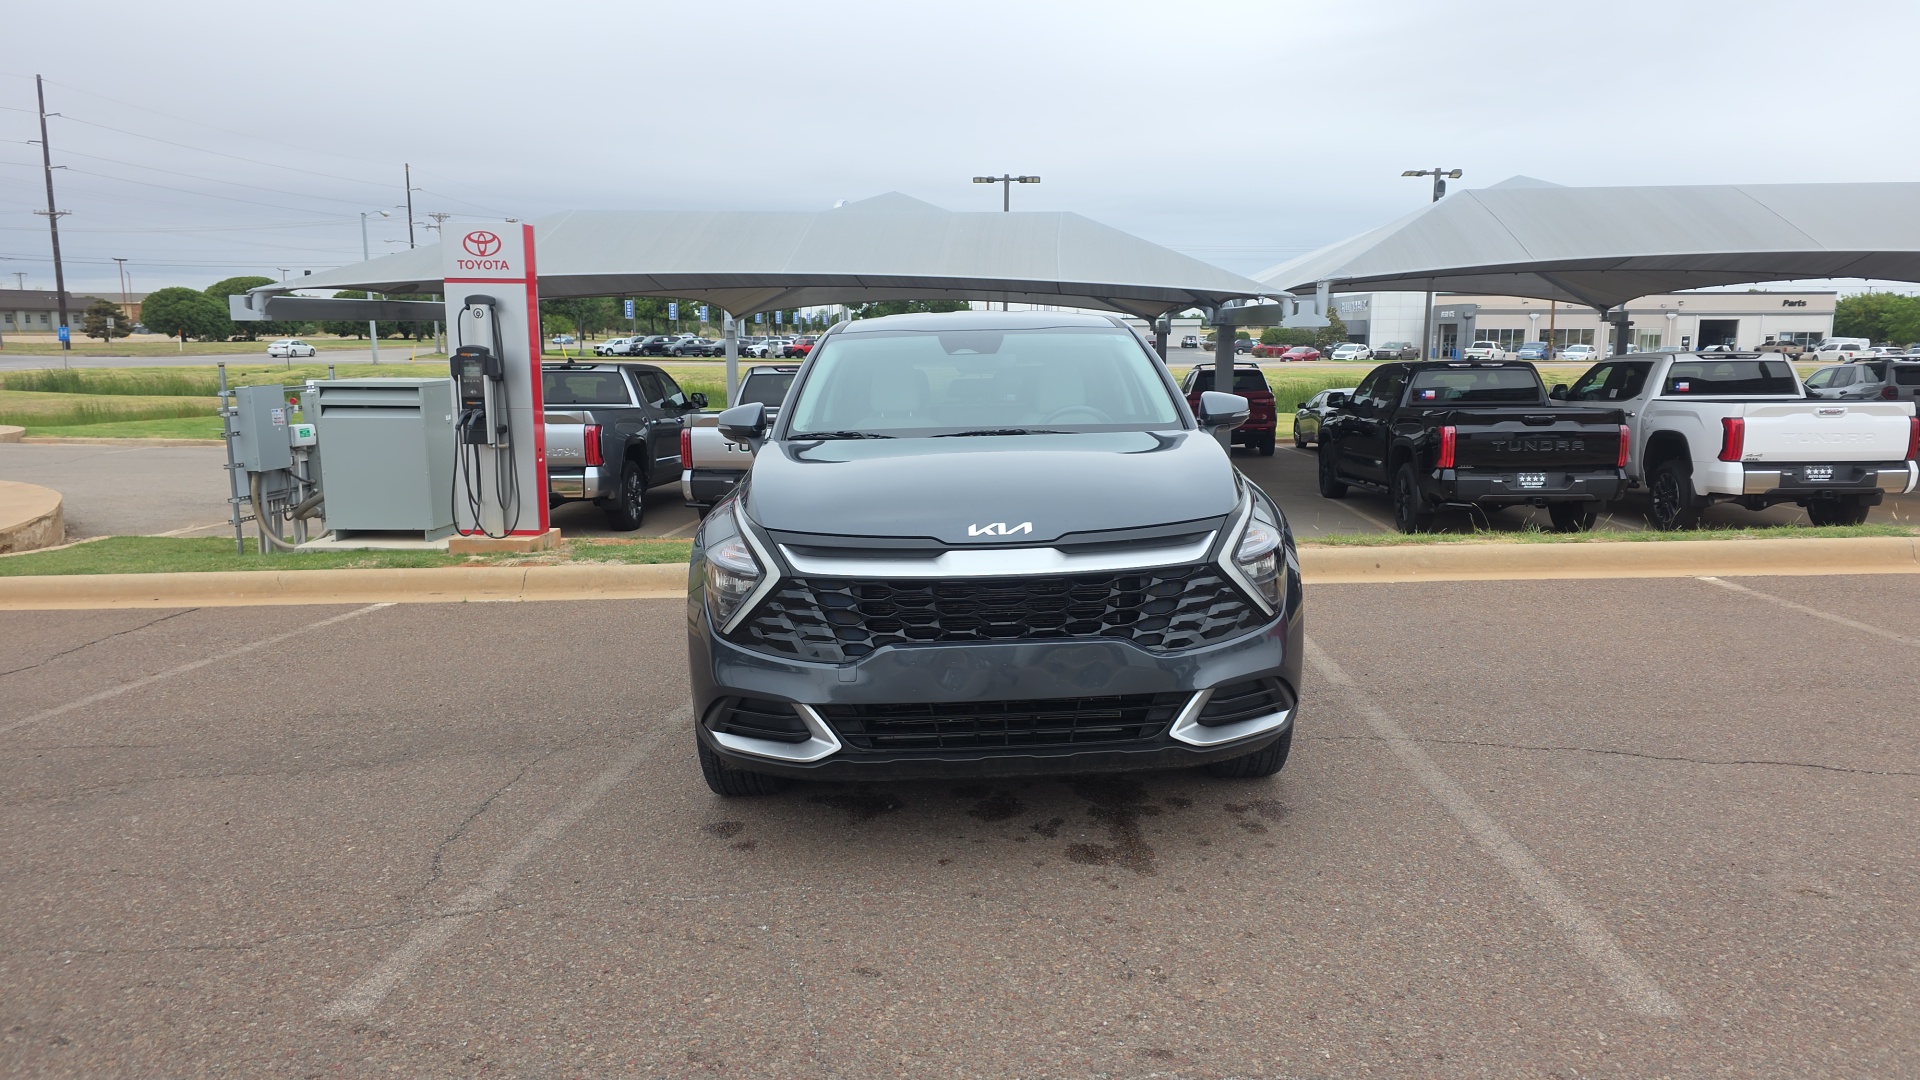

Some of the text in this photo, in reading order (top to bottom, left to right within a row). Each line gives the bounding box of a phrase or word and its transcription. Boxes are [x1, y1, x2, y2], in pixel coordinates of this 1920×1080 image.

[457, 260, 509, 270] TOYOTA
[1782, 299, 1807, 307] Parts
[60, 328, 67, 337] H
[1782, 432, 1877, 444] TUNDRA
[1492, 440, 1585, 451] TUNDRA
[552, 447, 579, 457] 1794
[968, 522, 1033, 537] KIA
